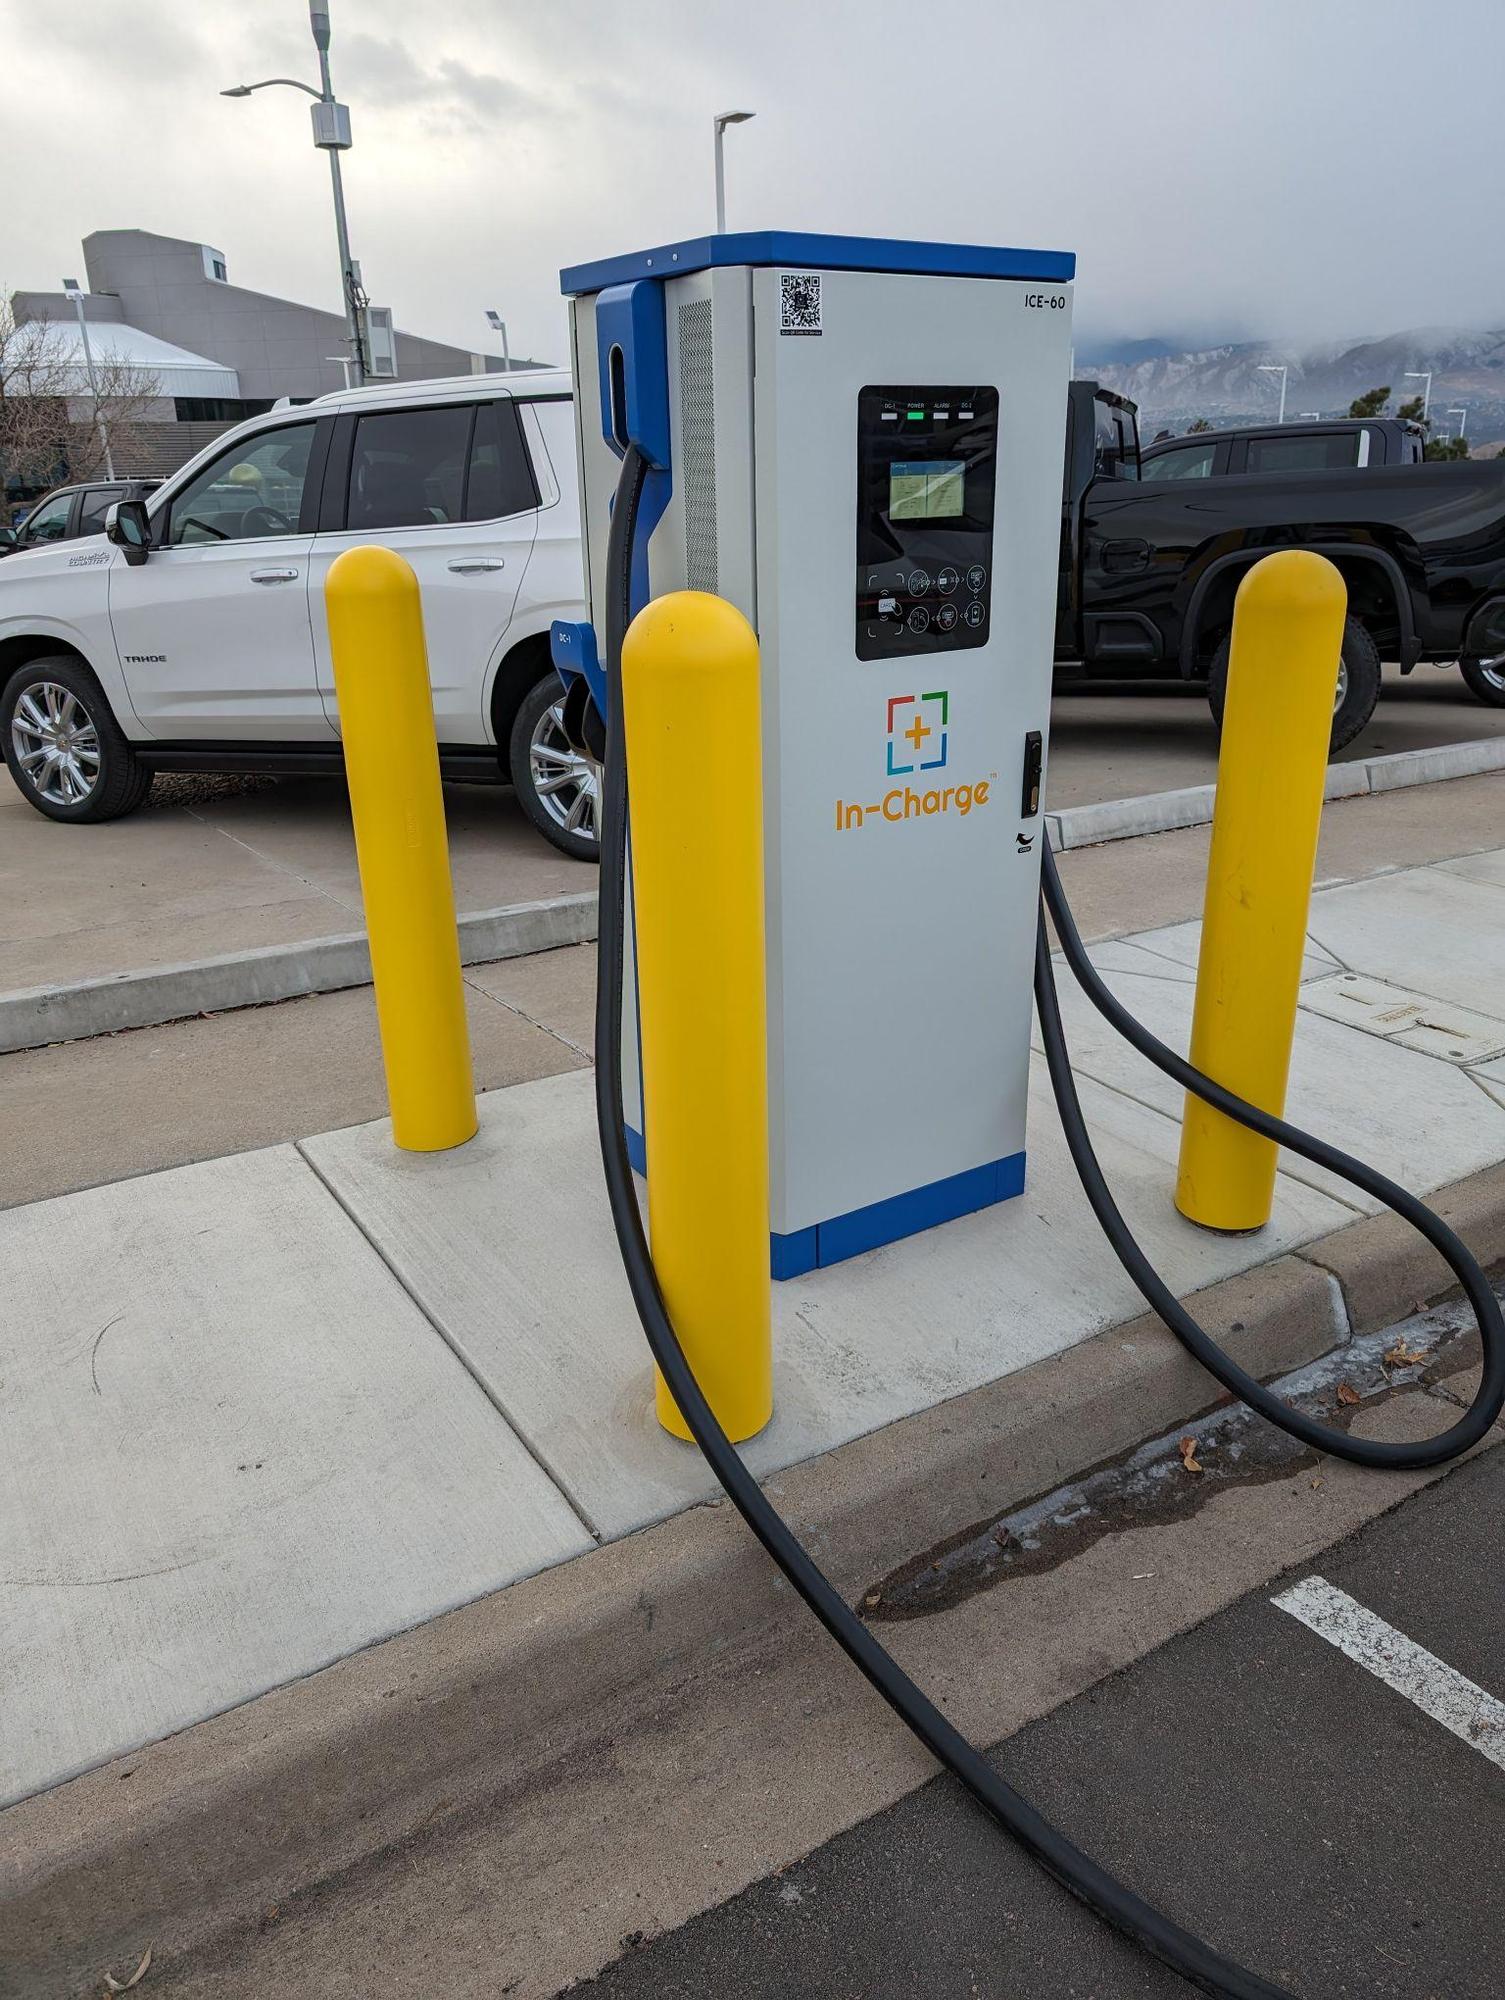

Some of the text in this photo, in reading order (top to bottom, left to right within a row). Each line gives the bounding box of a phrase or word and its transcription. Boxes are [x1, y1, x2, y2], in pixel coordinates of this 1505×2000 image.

[1025, 294, 1066, 309] ICE-60
[123, 655, 167, 663] TAHOE
[836, 781, 989, 831] In-Charge
